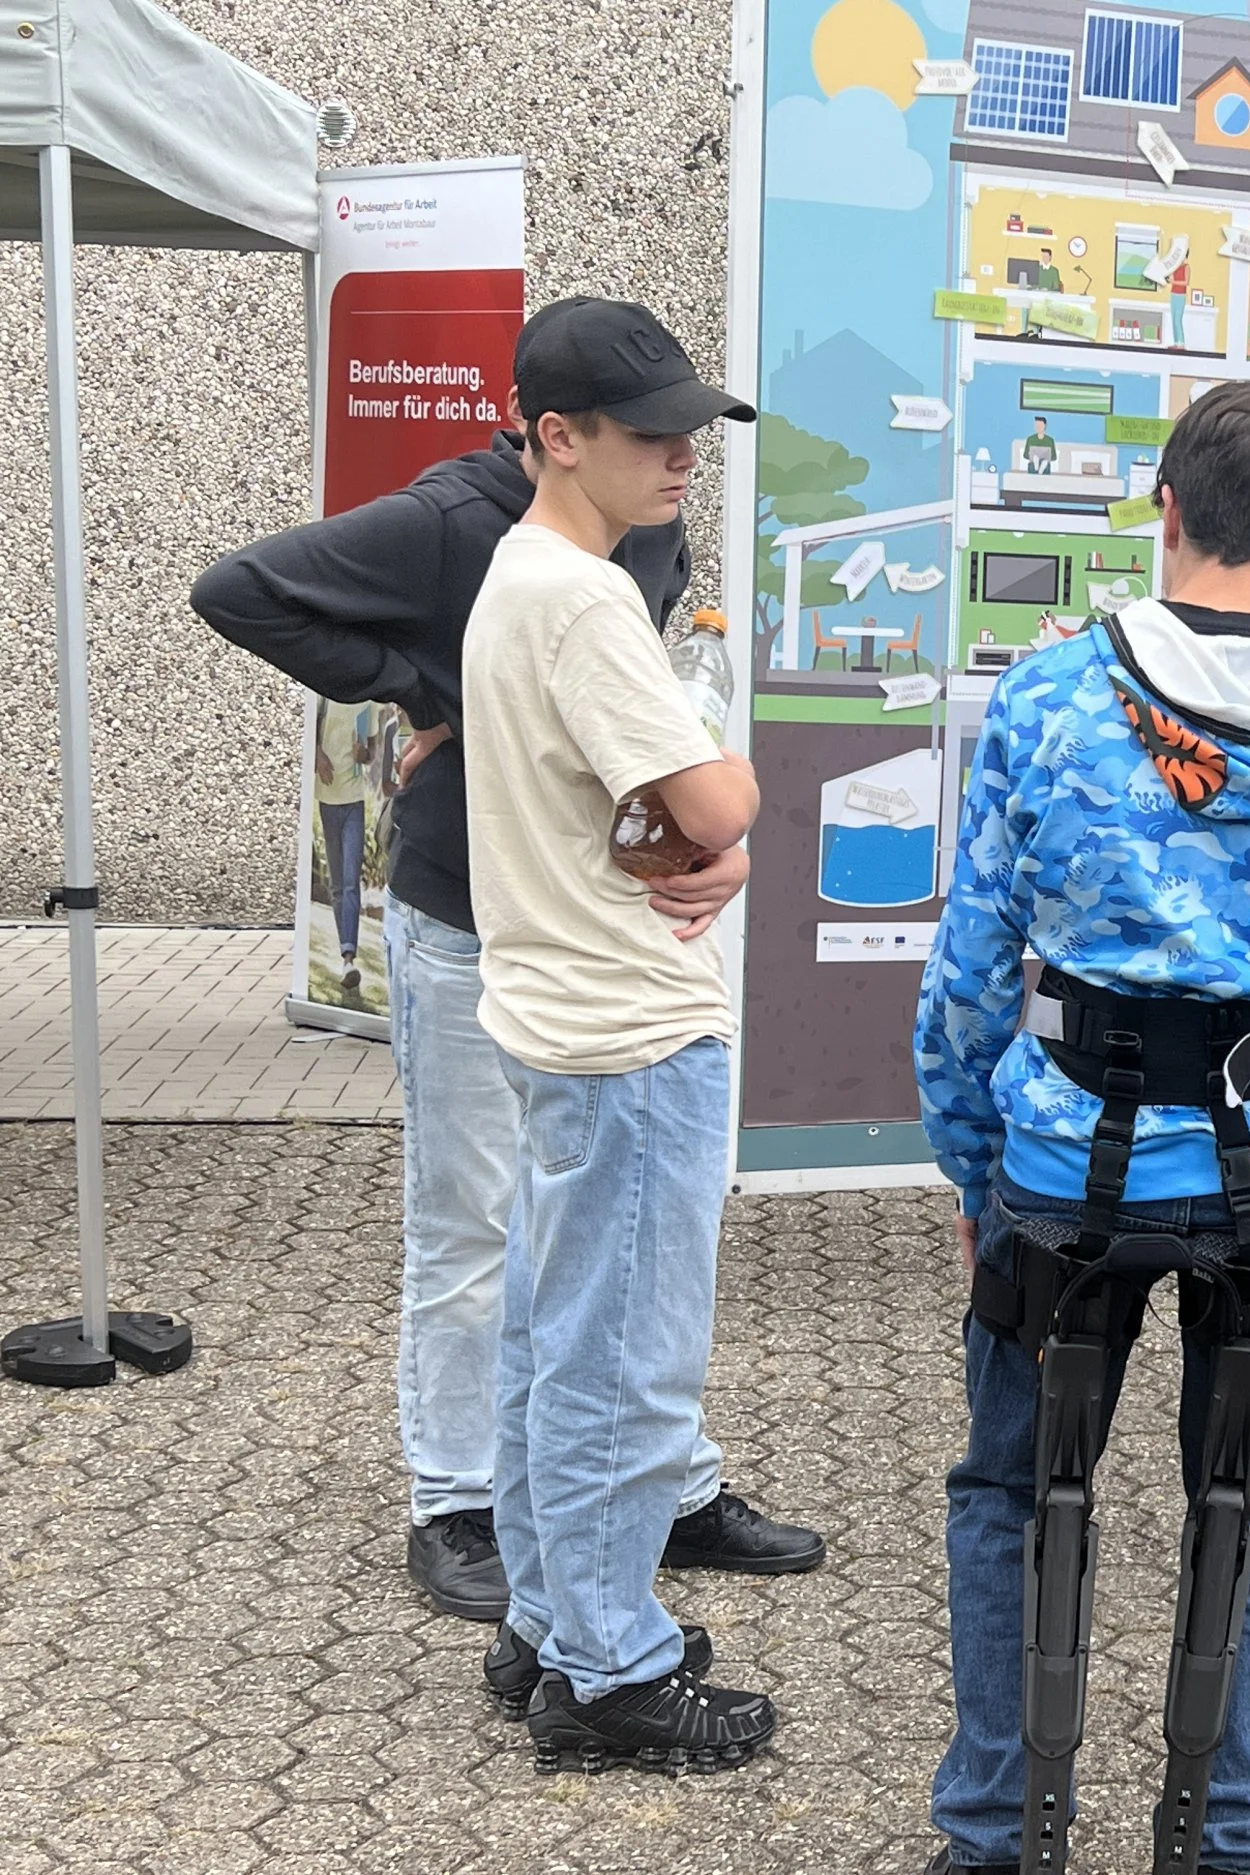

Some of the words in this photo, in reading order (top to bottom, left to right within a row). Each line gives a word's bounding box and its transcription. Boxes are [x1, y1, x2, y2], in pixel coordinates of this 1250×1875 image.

[354, 201, 402, 213] Bundesagentur
[404, 199, 413, 210] für
[415, 198, 437, 209] Arbeit
[349, 360, 485, 391] Berufsberatung.
[348, 394, 399, 418] Immer
[403, 395, 431, 420] für
[435, 397, 470, 421] dich
[475, 397, 501, 422] da.
[1042, 1851, 1050, 1860] M
[1174, 1846, 1182, 1854] M
